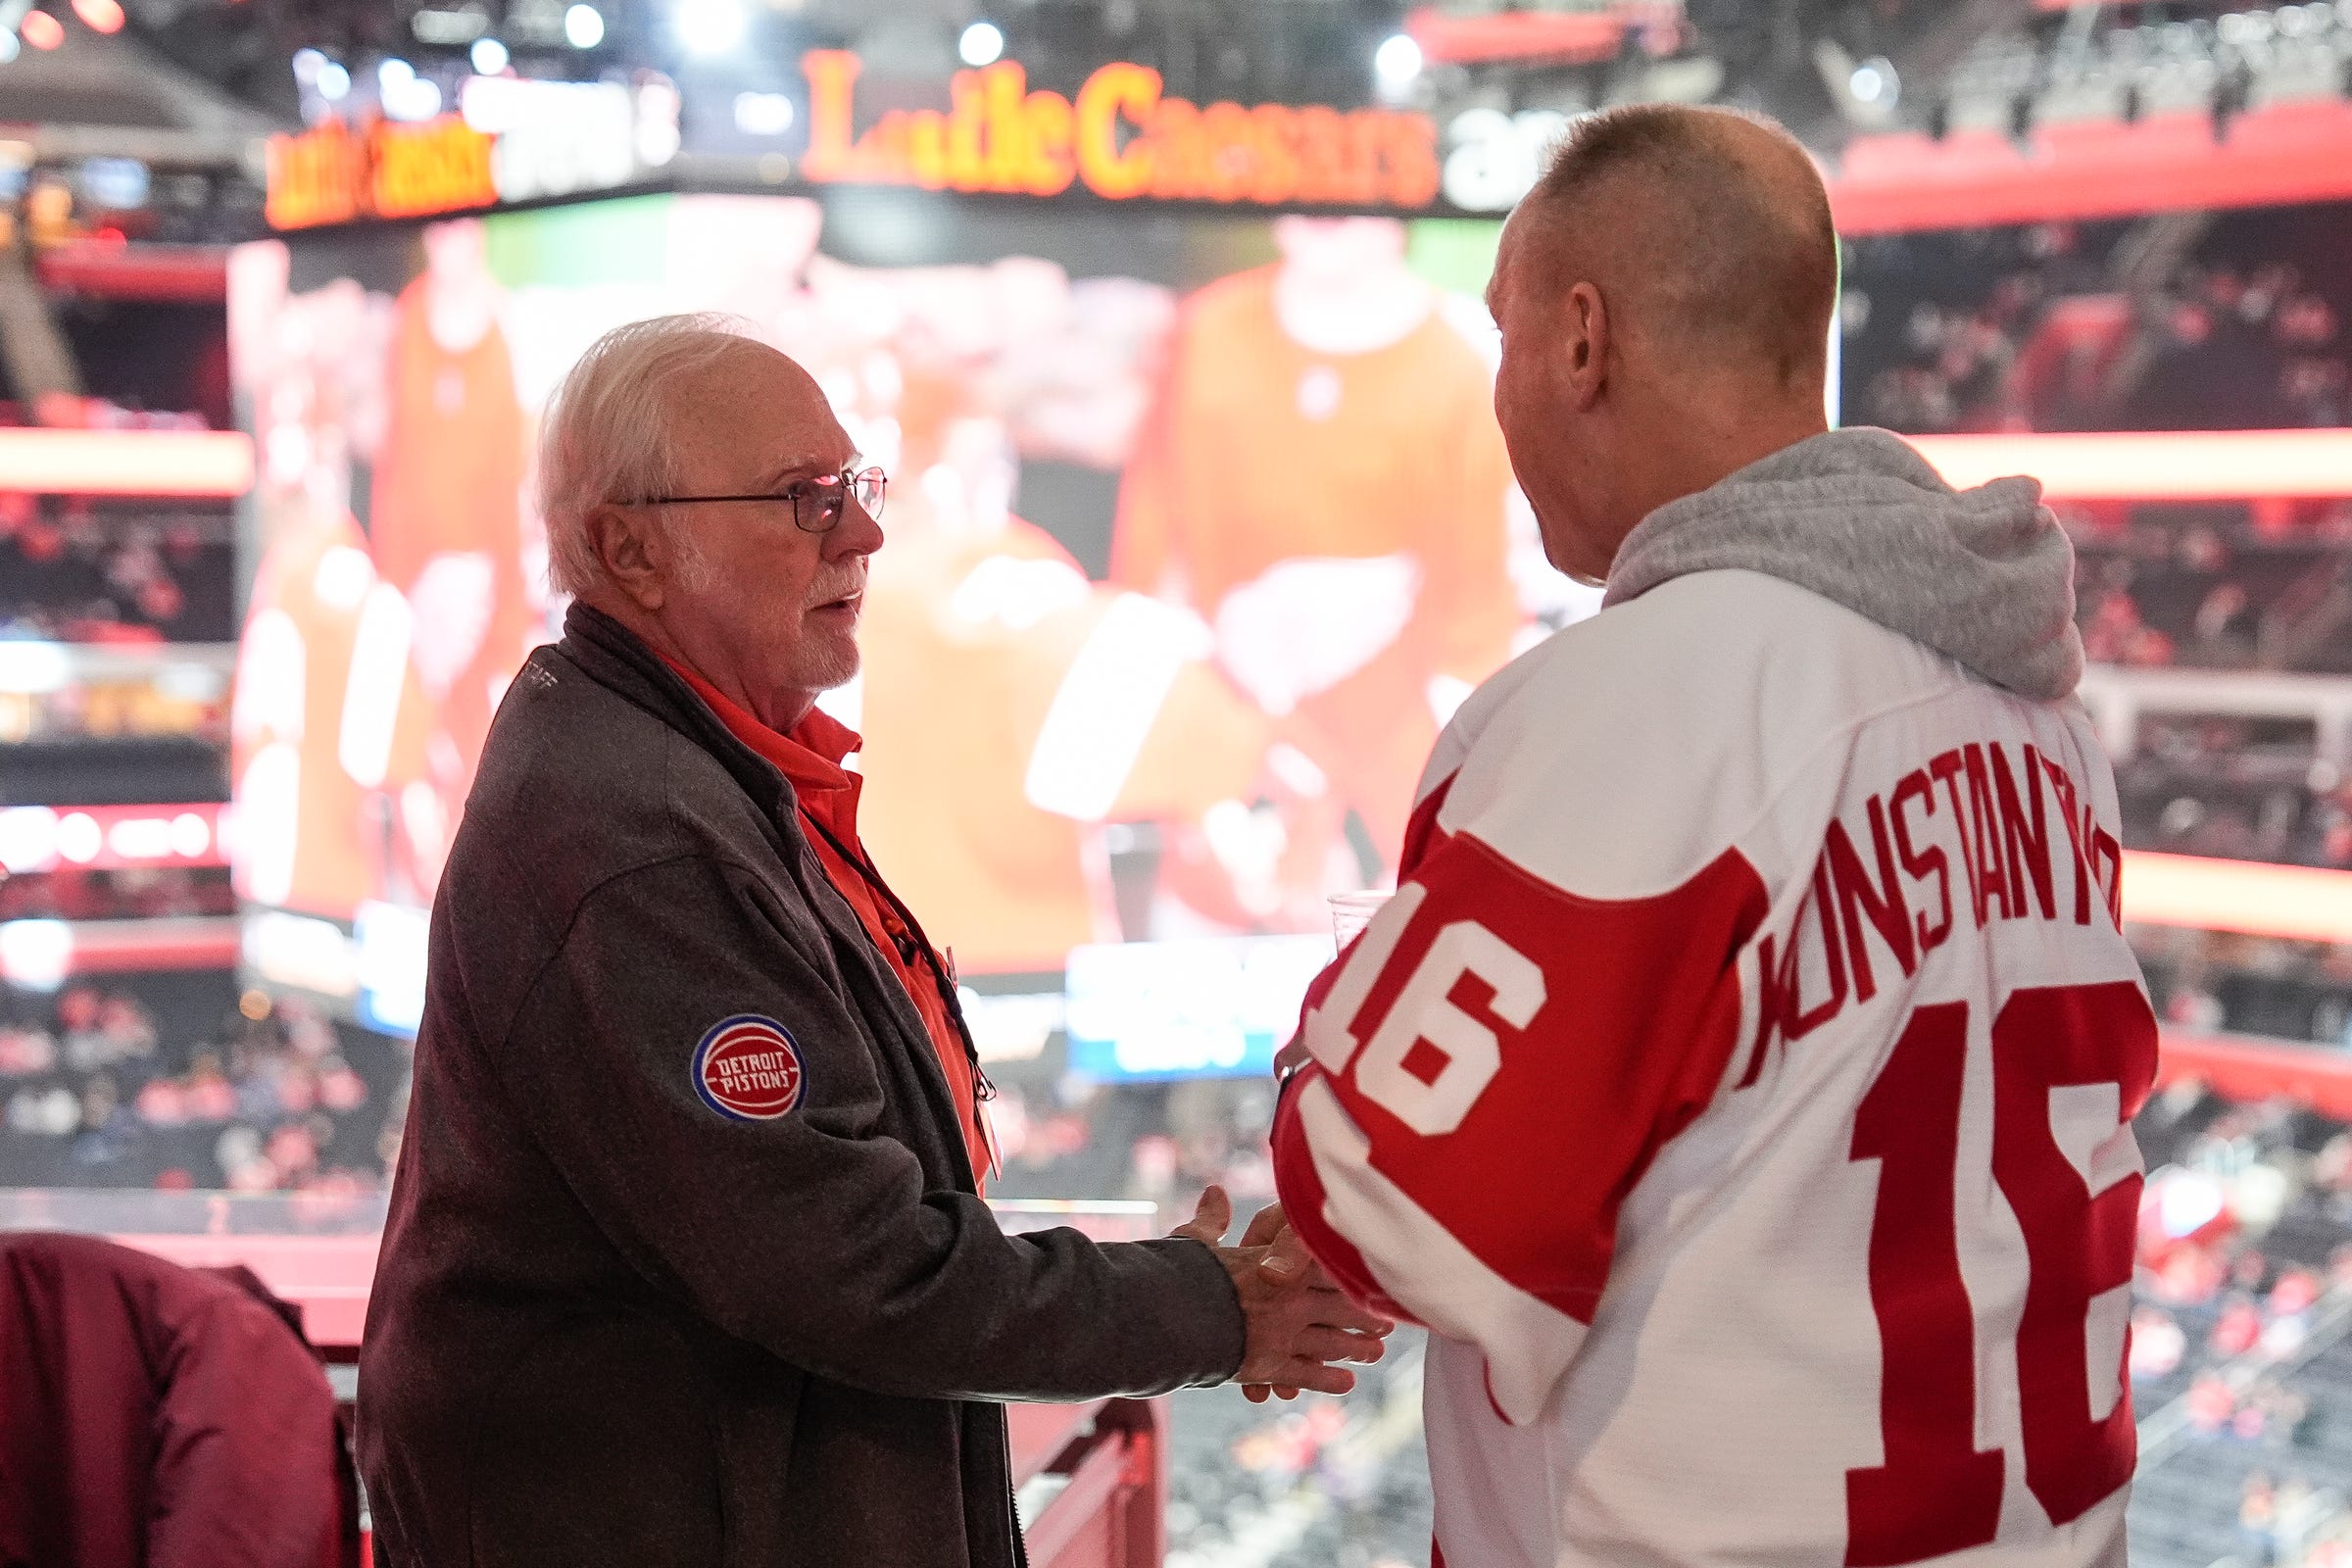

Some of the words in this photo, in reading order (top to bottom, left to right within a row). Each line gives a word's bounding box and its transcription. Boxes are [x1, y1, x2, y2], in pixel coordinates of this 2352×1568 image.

[715, 1052, 784, 1077] DETROIT
[1303, 880, 1548, 1137] 16
[719, 1070, 790, 1095] PISTONS
[1842, 980, 2160, 1568] 16
